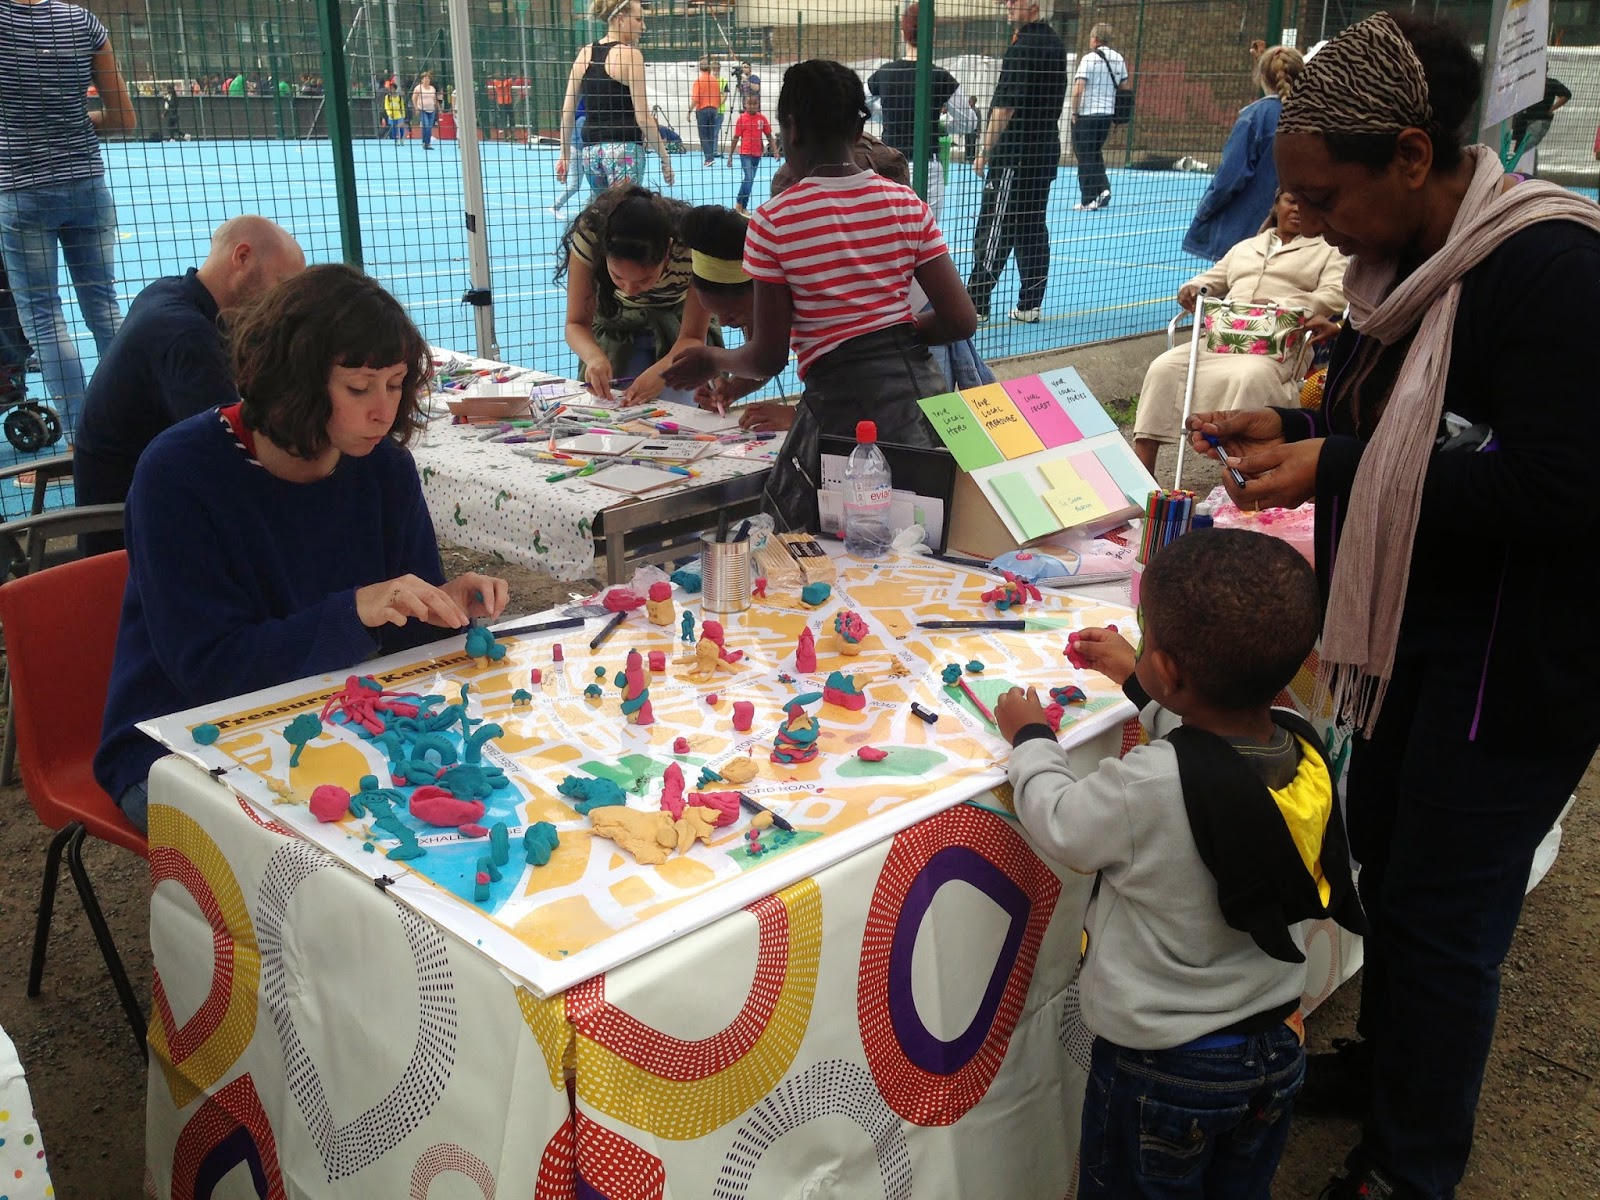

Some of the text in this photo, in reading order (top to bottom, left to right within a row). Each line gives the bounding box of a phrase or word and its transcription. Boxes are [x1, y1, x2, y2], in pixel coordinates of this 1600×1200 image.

[971, 398, 991, 409] YOUR
[981, 406, 1003, 418] LOCAL
[943, 414, 965, 425] LOCAL
[985, 414, 1017, 430] TREASURE
[946, 424, 967, 436] HERO
[213, 690, 340, 730] Treasure
[778, 783, 816, 792] ROAD
